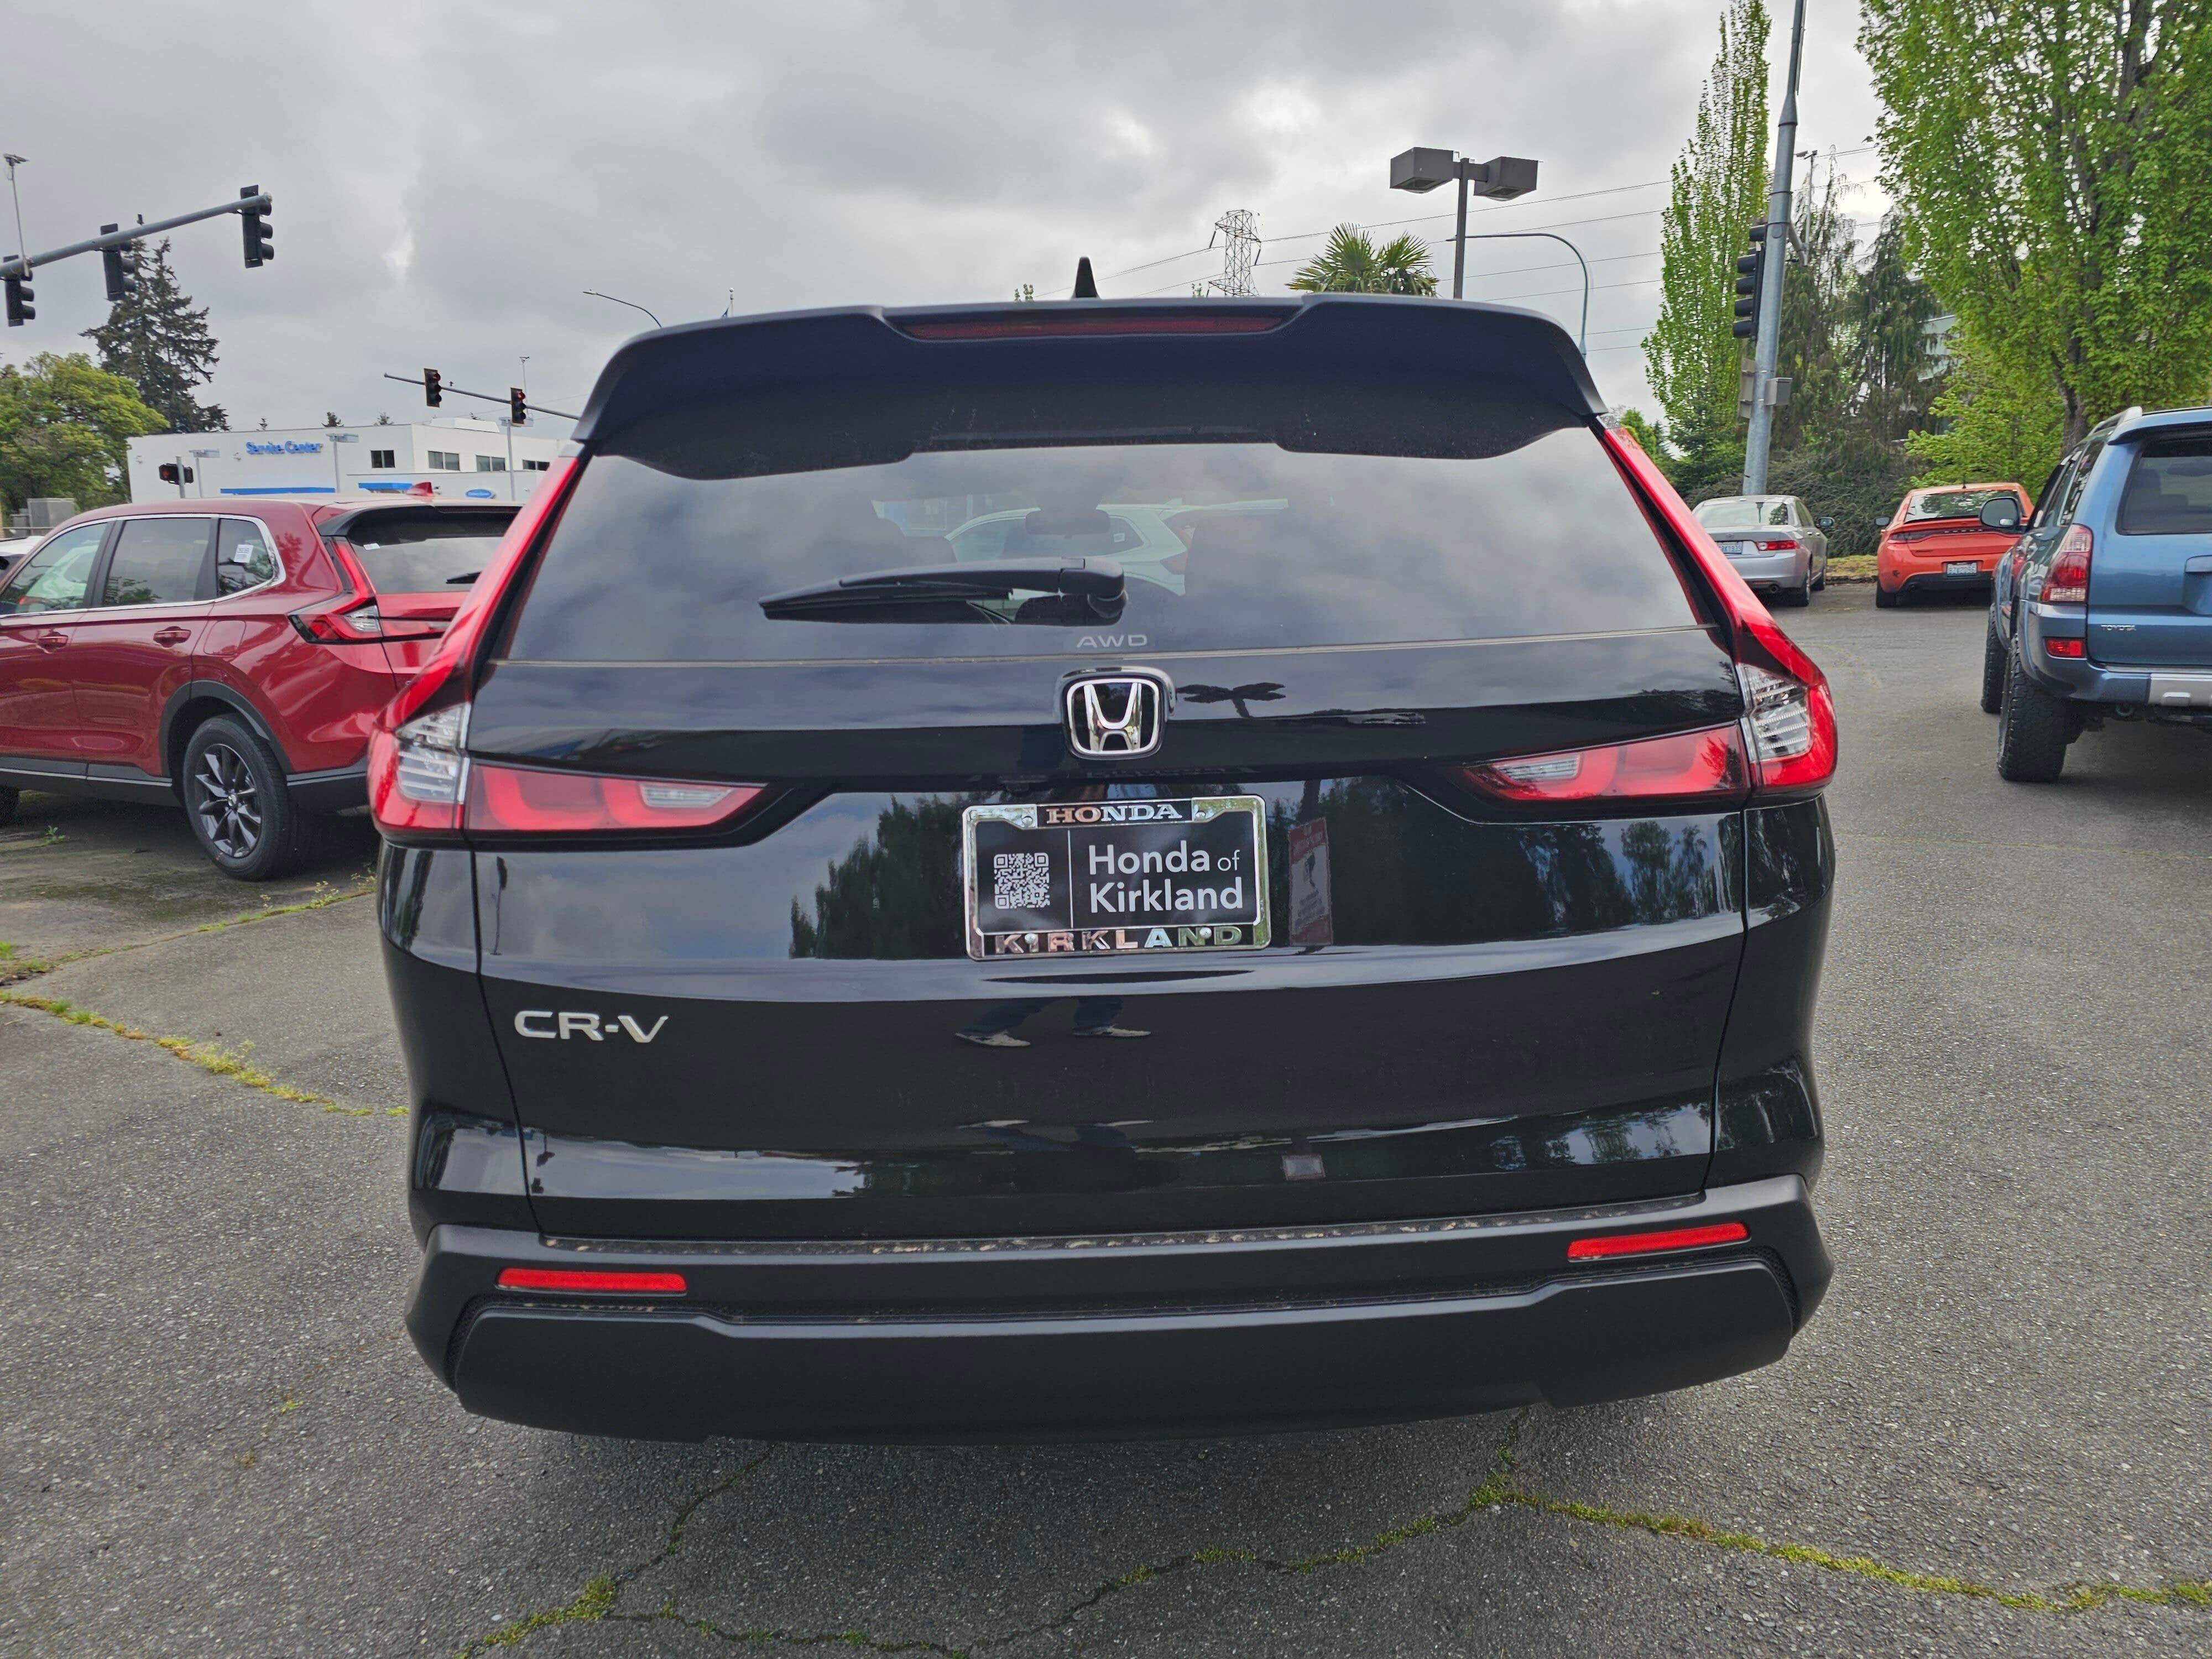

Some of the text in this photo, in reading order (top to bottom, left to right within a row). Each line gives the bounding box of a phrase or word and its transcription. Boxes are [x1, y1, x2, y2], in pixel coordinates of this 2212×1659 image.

[284, 441, 323, 453] Center
[1077, 634, 1148, 648] AWD
[1046, 804, 1183, 824] HONDA
[1089, 840, 1240, 875] Honda of
[1090, 877, 1243, 913] Kirkland
[514, 1010, 669, 1043] CR-V
